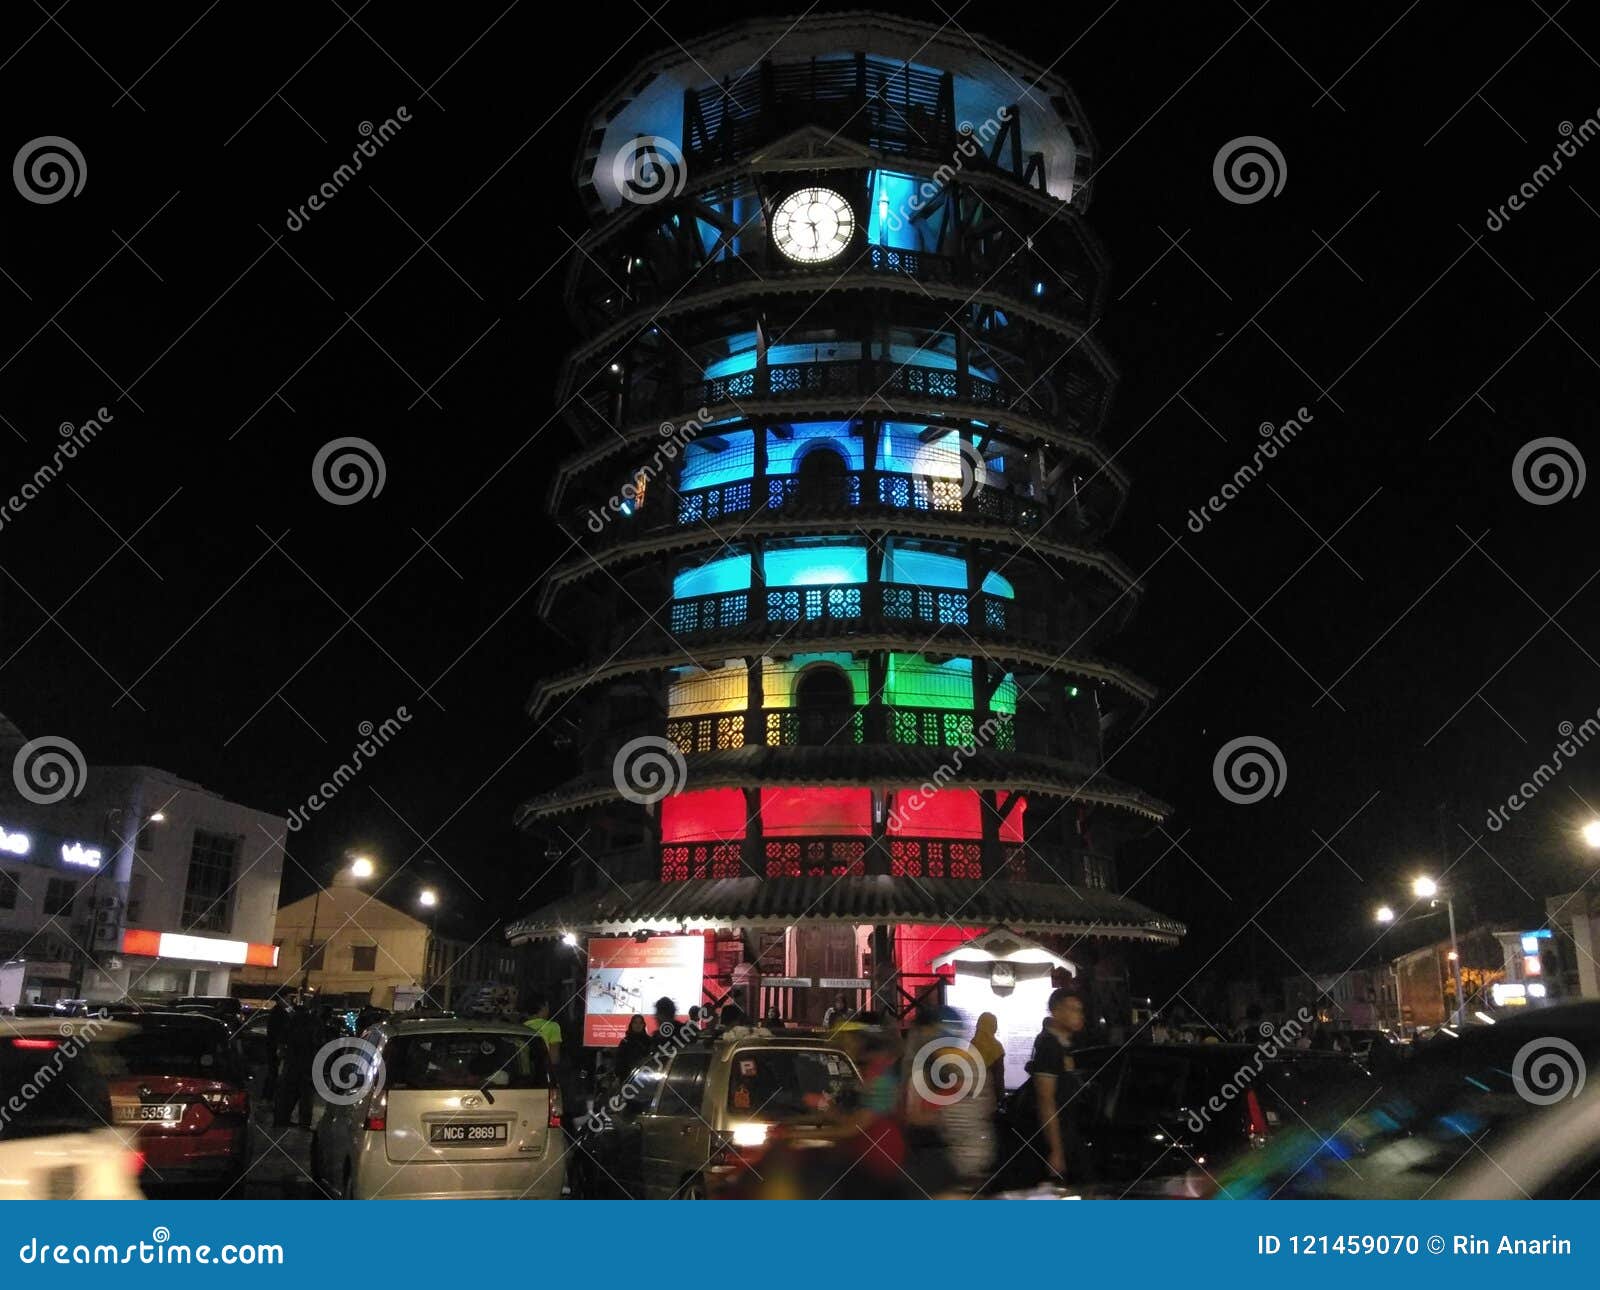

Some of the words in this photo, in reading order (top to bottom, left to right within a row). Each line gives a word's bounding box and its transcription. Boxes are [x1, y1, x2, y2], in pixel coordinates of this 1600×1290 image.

[141, 1107, 172, 1119] 5352
[443, 1127, 465, 1139] NCG
[467, 1127, 495, 1139] 2869
